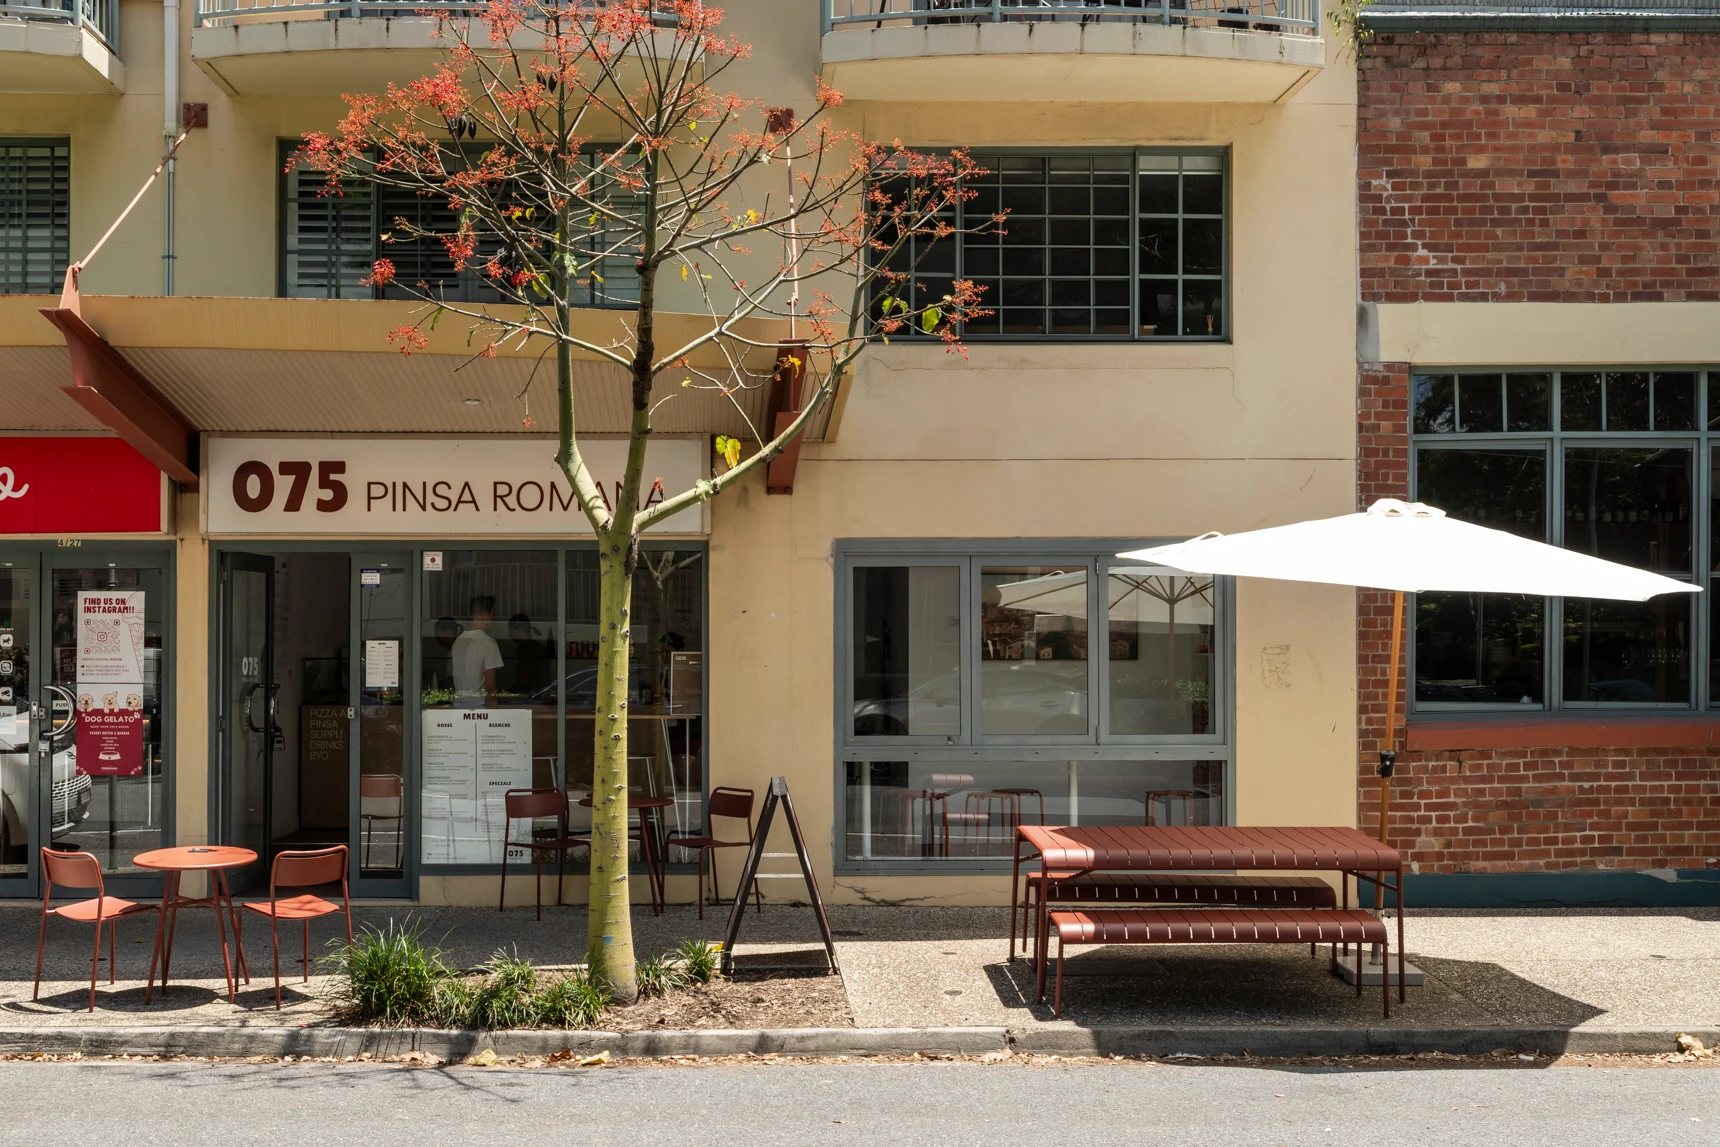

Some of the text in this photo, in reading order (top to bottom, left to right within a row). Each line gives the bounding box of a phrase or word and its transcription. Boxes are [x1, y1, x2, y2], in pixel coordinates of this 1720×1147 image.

[232, 460, 348, 512] 075
[366, 480, 480, 512] PINSA
[242, 656, 258, 675] 075
[310, 709, 338, 718] PIZZA
[310, 720, 338, 728] PINSA
[310, 740, 344, 750] DRINKS
[310, 751, 329, 760] BYO
